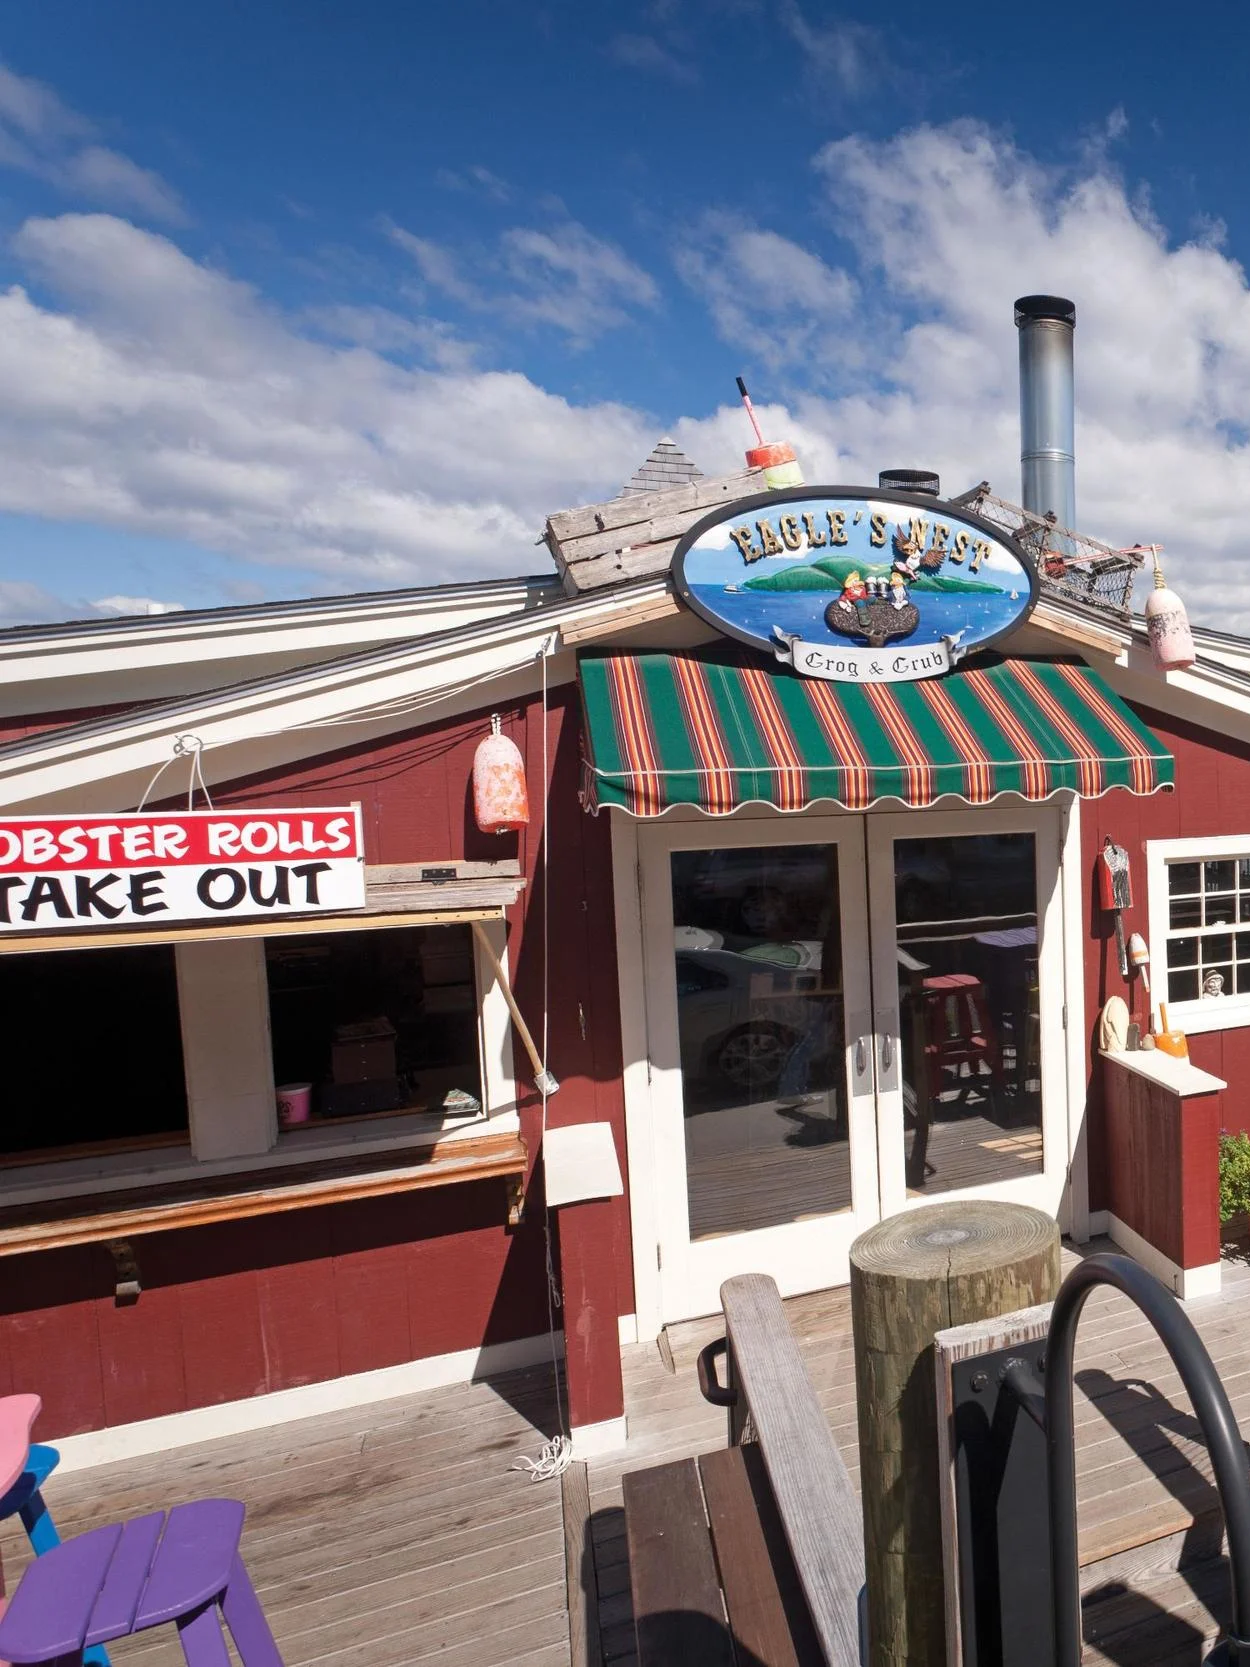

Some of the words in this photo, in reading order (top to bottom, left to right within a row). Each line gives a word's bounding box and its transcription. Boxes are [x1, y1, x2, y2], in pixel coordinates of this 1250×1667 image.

[730, 510, 887, 565] EAGLE'S
[908, 517, 992, 573] NEST
[869, 661, 884, 675] &
[0, 824, 190, 866] OBSTER
[208, 818, 351, 857] ROLLS
[0, 871, 170, 923] TAKE
[197, 862, 332, 910] OUT
